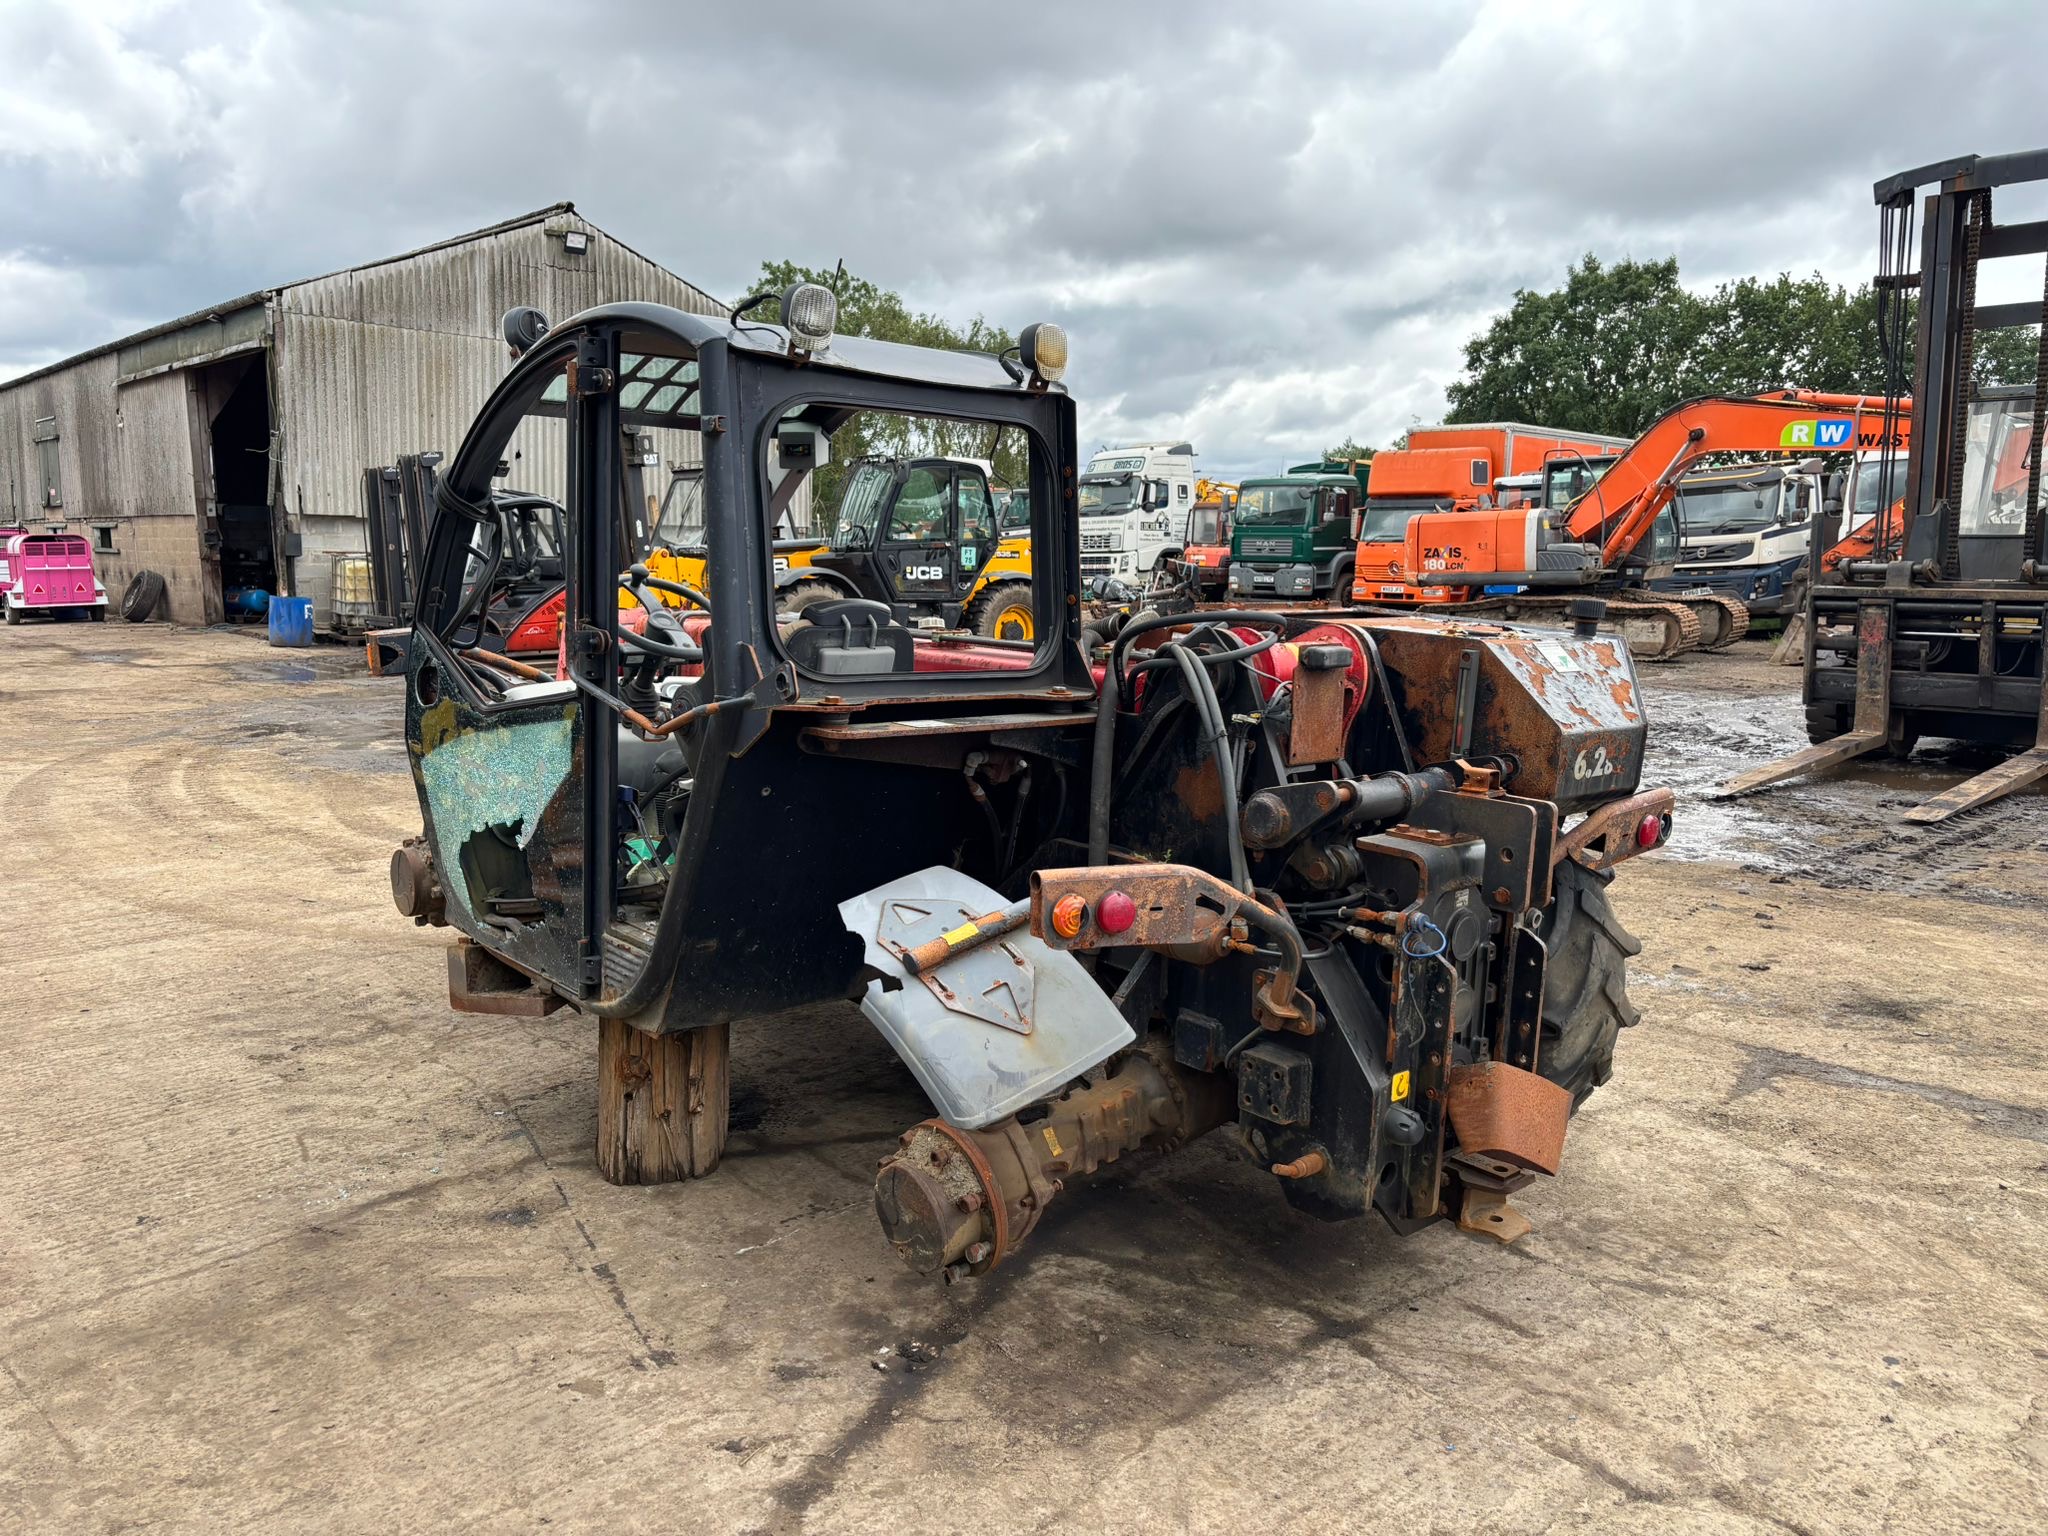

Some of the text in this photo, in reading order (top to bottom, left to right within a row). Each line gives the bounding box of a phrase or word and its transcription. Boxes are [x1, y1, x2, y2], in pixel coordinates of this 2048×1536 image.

[1256, 540, 1276, 548] MAN
[1424, 546, 1462, 559] ZAXIS
[906, 566, 943, 580] JCB
